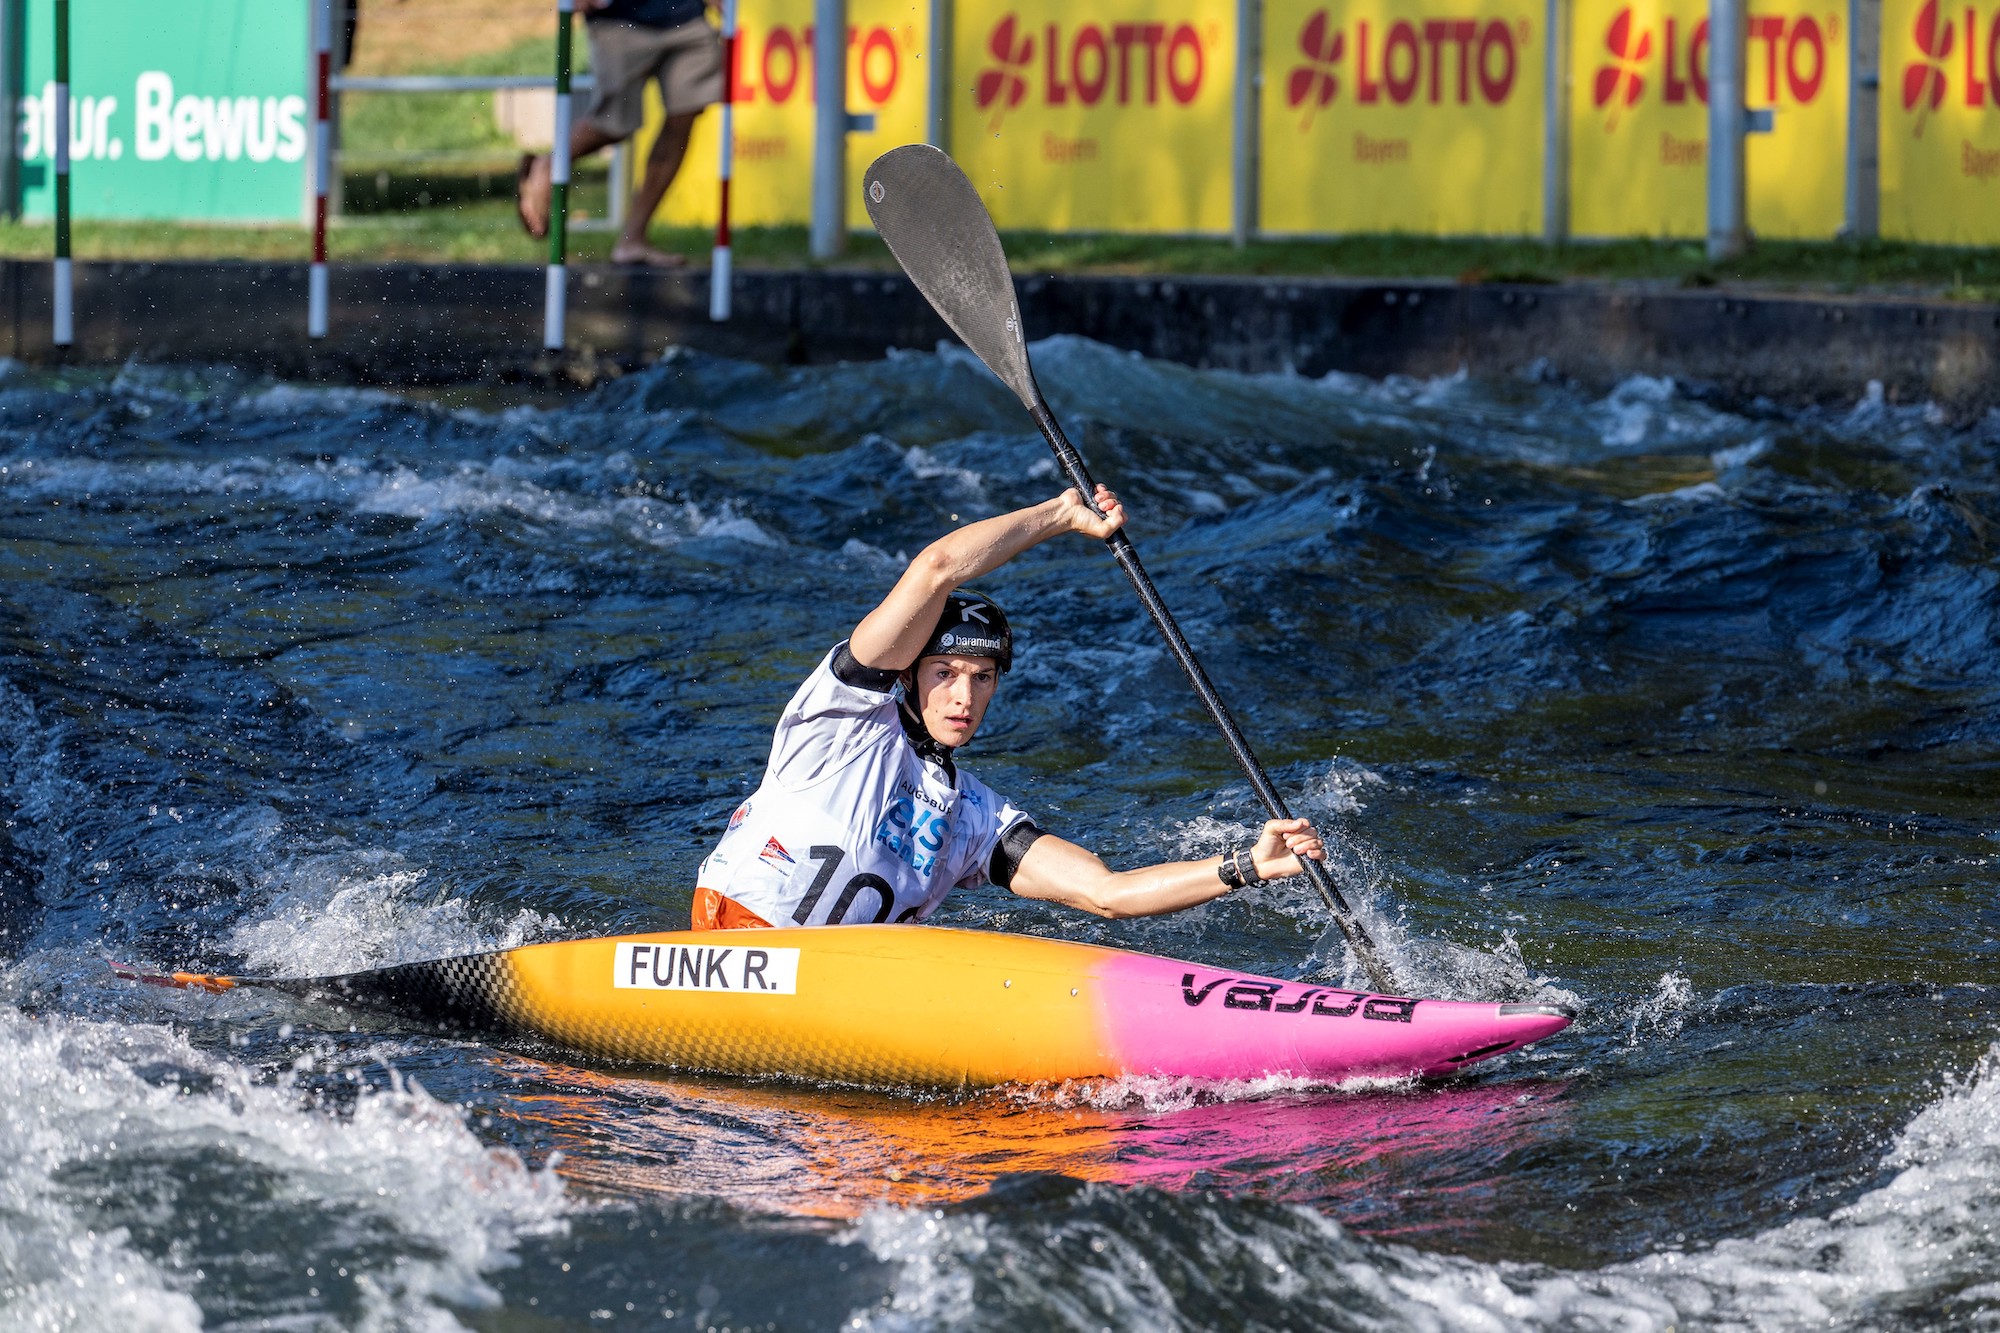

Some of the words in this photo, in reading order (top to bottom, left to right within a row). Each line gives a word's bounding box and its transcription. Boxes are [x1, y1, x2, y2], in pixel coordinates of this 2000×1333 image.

[732, 25, 898, 104] LOO
[1046, 23, 1203, 105] LOTTO
[1357, 19, 1517, 105] LOTTO
[1663, 16, 1825, 105] LOTO
[135, 70, 307, 163] Bewus
[955, 634, 1001, 650] baramundi
[631, 946, 732, 988] FUNK
[743, 950, 777, 990] R.
